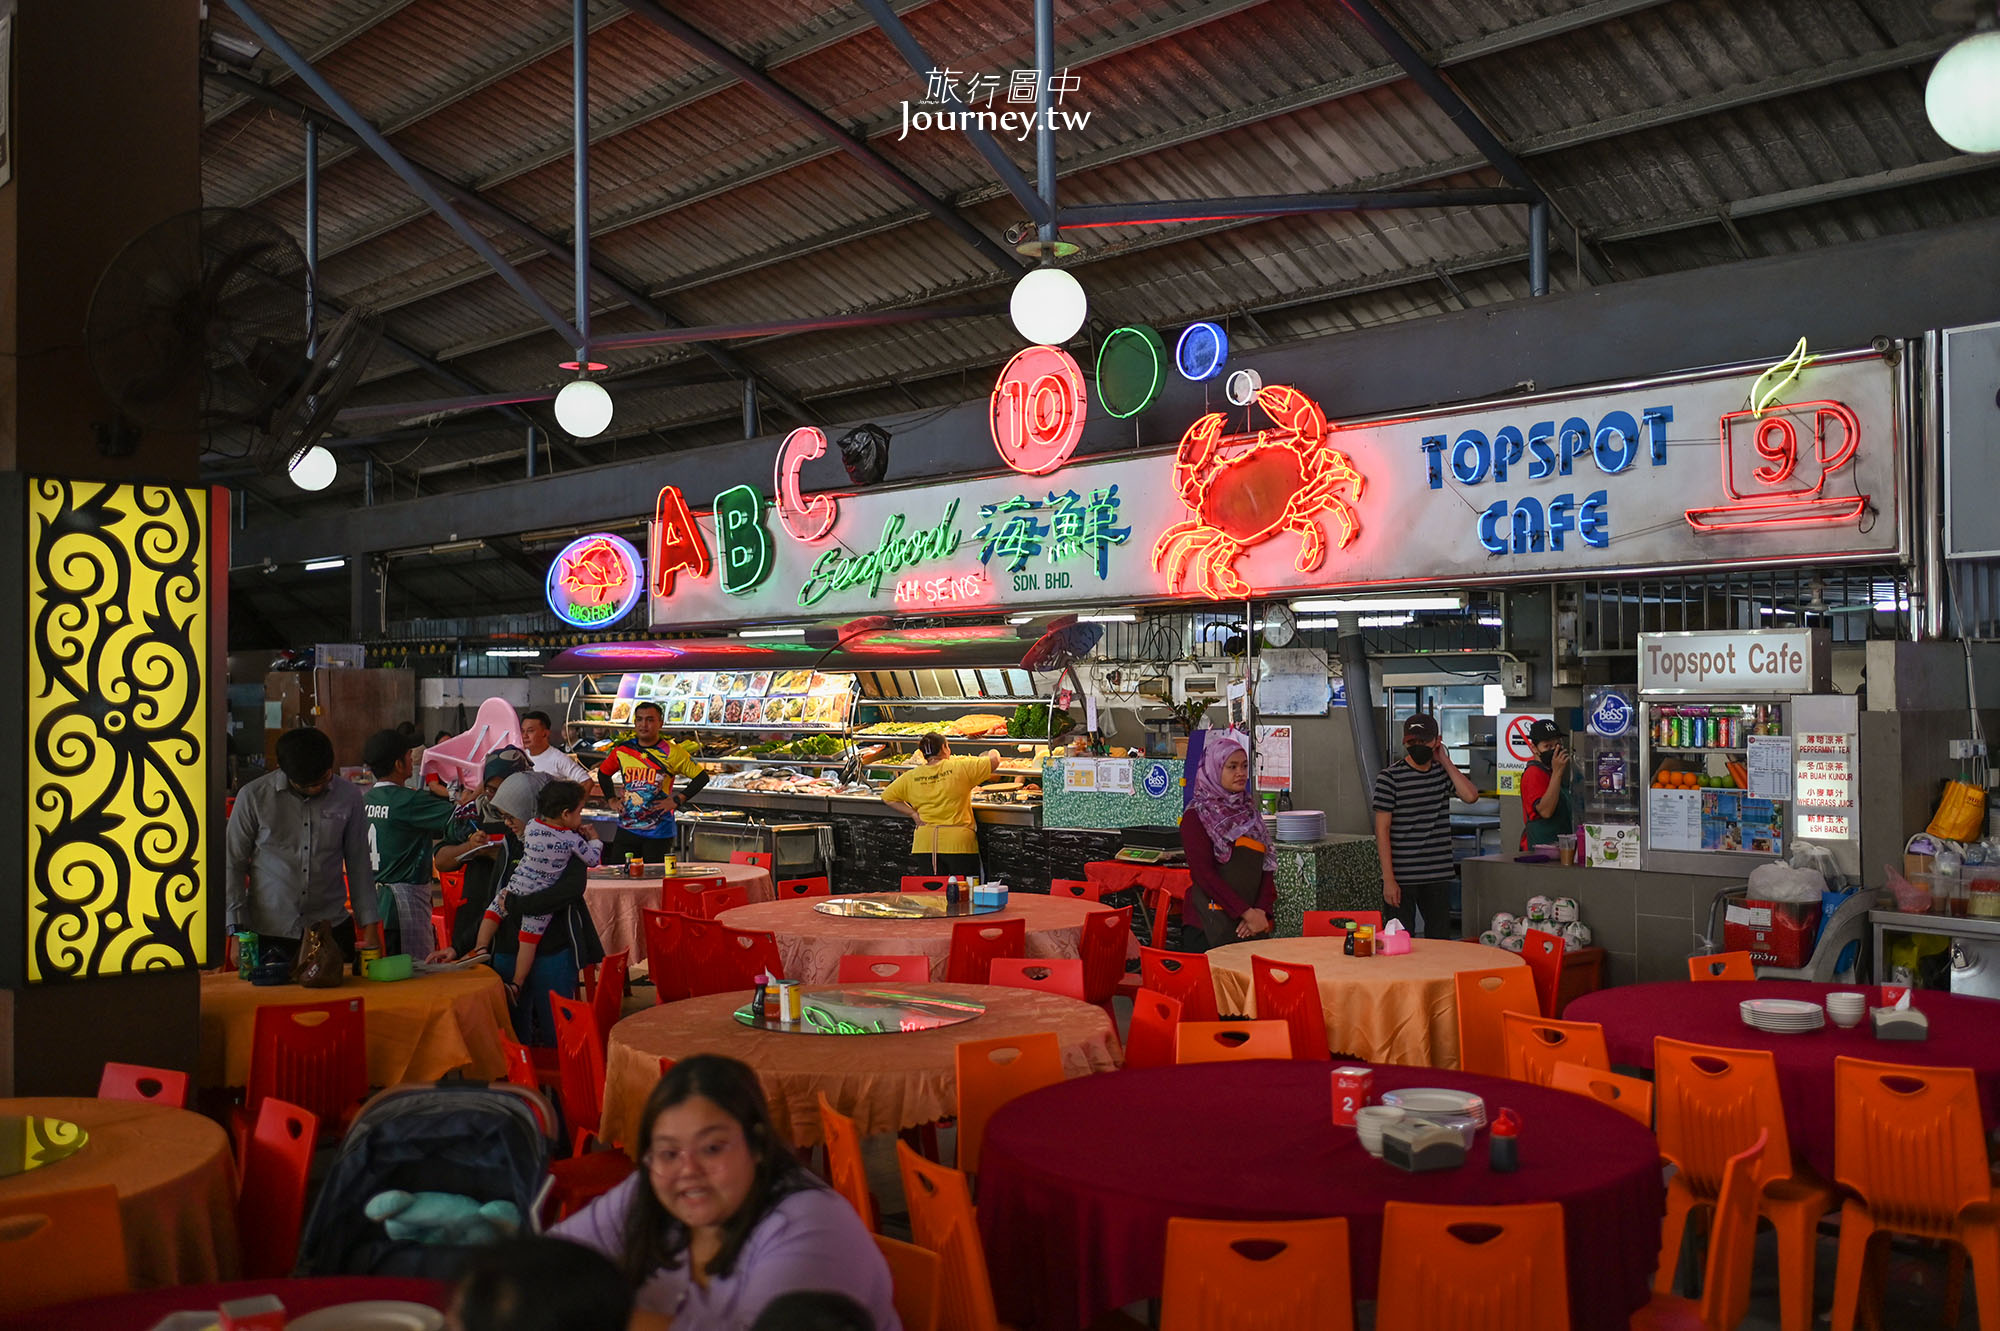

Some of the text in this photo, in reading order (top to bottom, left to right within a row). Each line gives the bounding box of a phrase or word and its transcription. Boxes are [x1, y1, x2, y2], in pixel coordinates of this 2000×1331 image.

[1002, 374, 1072, 449] 10
[1421, 404, 1674, 490] TOPSPOT
[1752, 416, 1798, 486] 9
[971, 483, 1132, 581] 海鮮
[1476, 489, 1609, 556] CAFE
[796, 496, 963, 607] Seafood
[924, 575, 984, 602] SENG
[1013, 571, 1074, 592] SDN. BHD.
[568, 600, 615, 622] BBQ FISH
[1647, 642, 1803, 682] Topspot Cafe
[1799, 745, 1850, 754] PEPPERMINT TEA
[625, 766, 657, 785] STYLO
[1798, 772, 1853, 781] AIR BUAH KUNDUR
[1797, 798, 1854, 808] WHEATGRASS JUICE
[1824, 826, 1848, 834] BARLEY
[1343, 1096, 1353, 1112] 2
